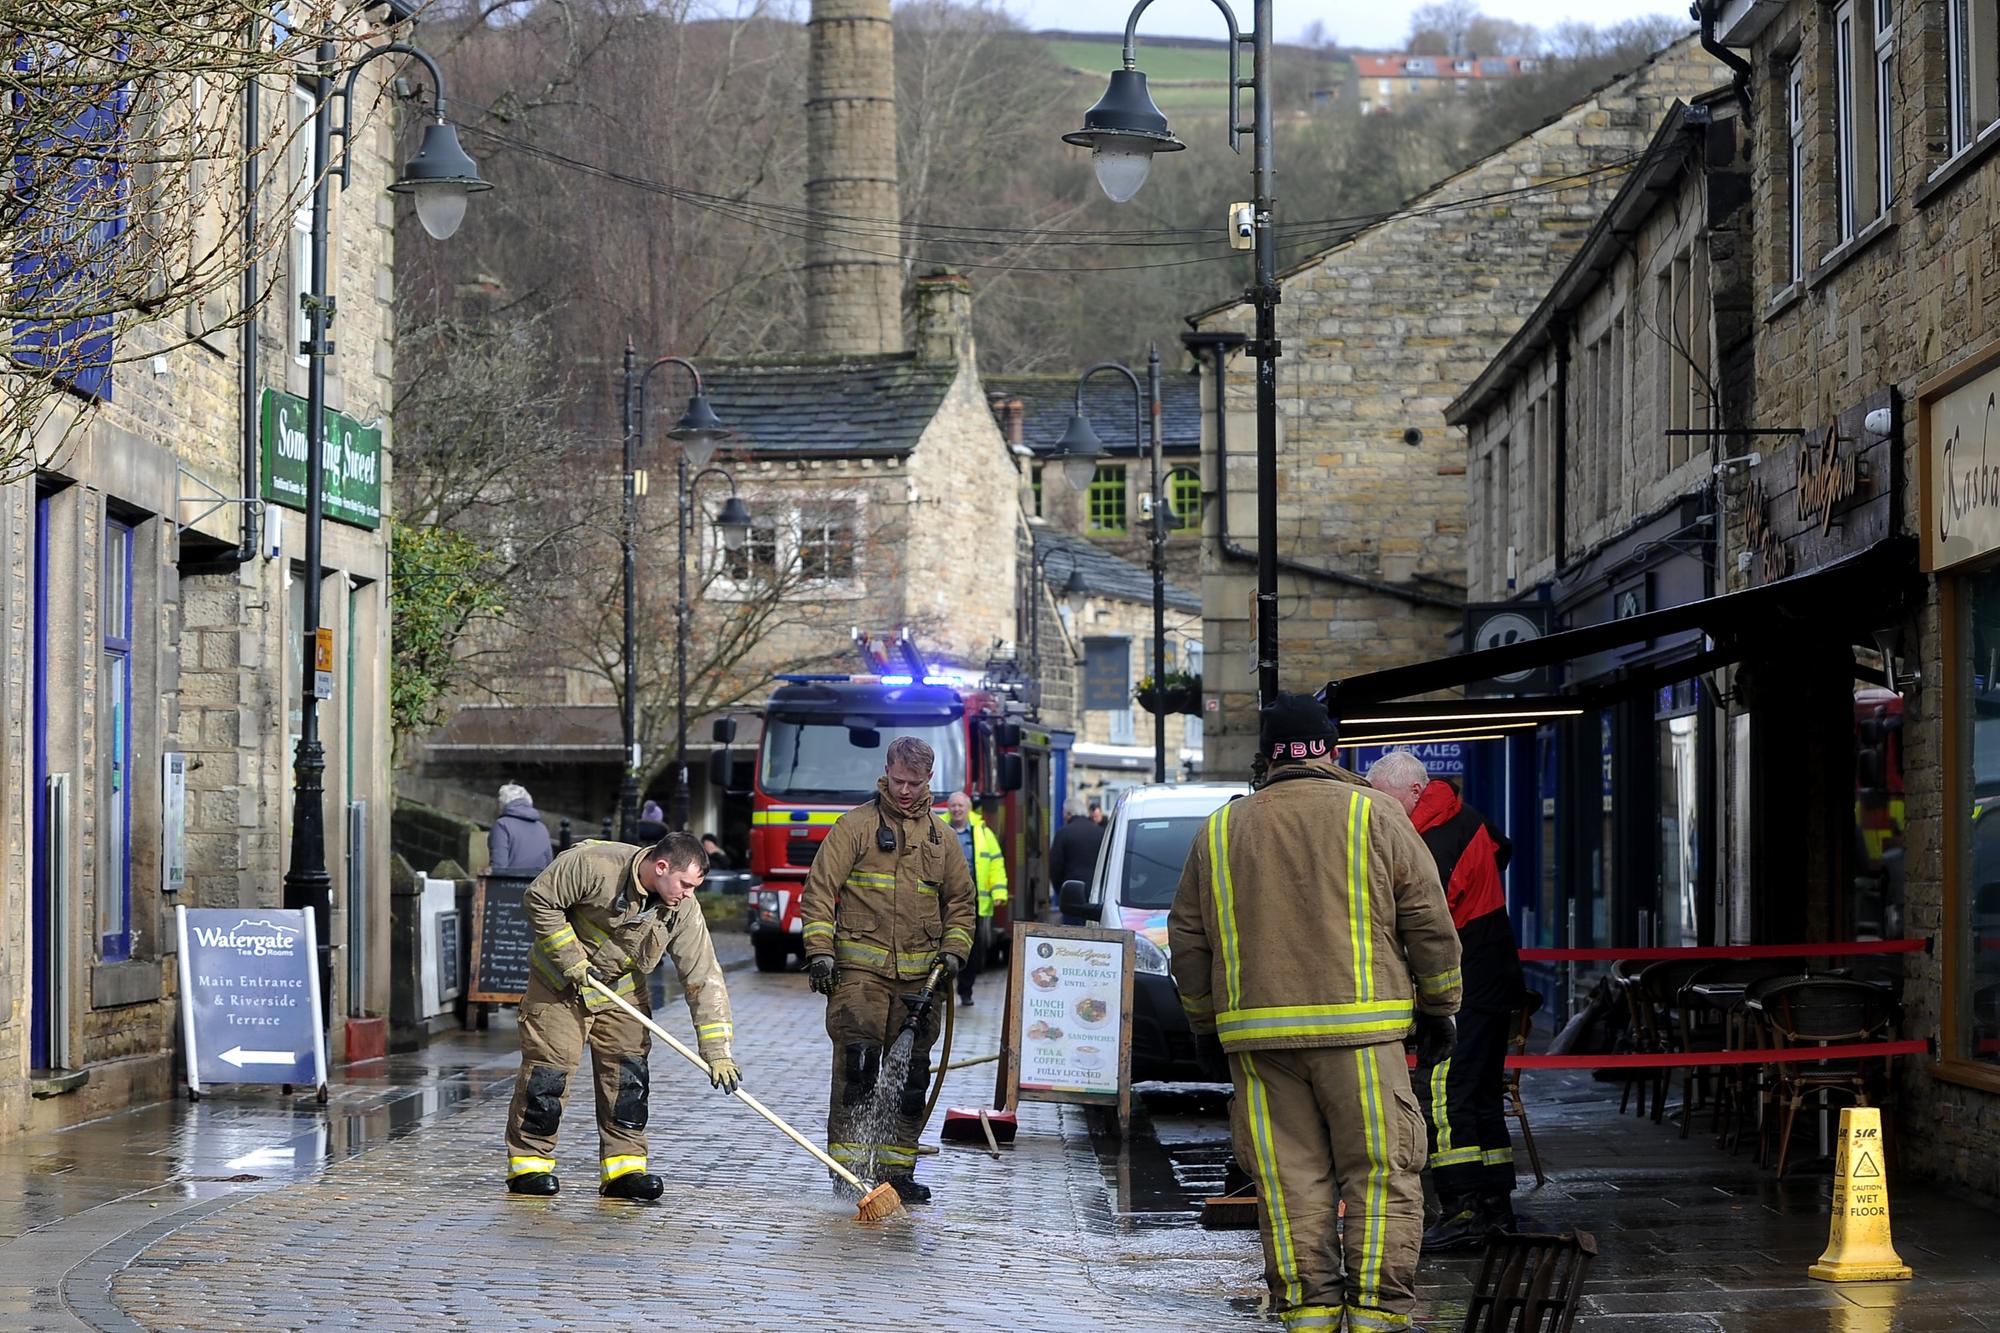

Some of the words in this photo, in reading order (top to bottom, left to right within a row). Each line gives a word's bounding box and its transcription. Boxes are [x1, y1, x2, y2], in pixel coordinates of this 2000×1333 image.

[278, 408, 341, 486] Soming
[344, 431, 376, 485] Sweet
[1940, 391, 2000, 543] Kasba
[1272, 739, 1326, 759] FBU
[1423, 744, 1461, 757] ALES
[193, 927, 294, 956] Watergate
[1062, 968, 1117, 979] BREAKFAST
[199, 976, 233, 987] Main
[240, 976, 303, 988] Entrance
[214, 995, 224, 1006] &
[231, 995, 296, 1007] Riverside
[1030, 999, 1064, 1009] LUNCH
[1034, 1009, 1064, 1018] MENU
[227, 1014, 280, 1026] Terrace
[1068, 1033, 1115, 1042] SANDWICHES
[1037, 1048, 1055, 1056] TEA
[1034, 1056, 1065, 1065] COFFEE
[1037, 1068, 1061, 1076] FULLY
[1063, 1069, 1101, 1079] LICENSED
[1854, 1128, 1877, 1138] SIR
[1856, 1194, 1878, 1203] WET
[1851, 1207, 1885, 1216] FLOOR
